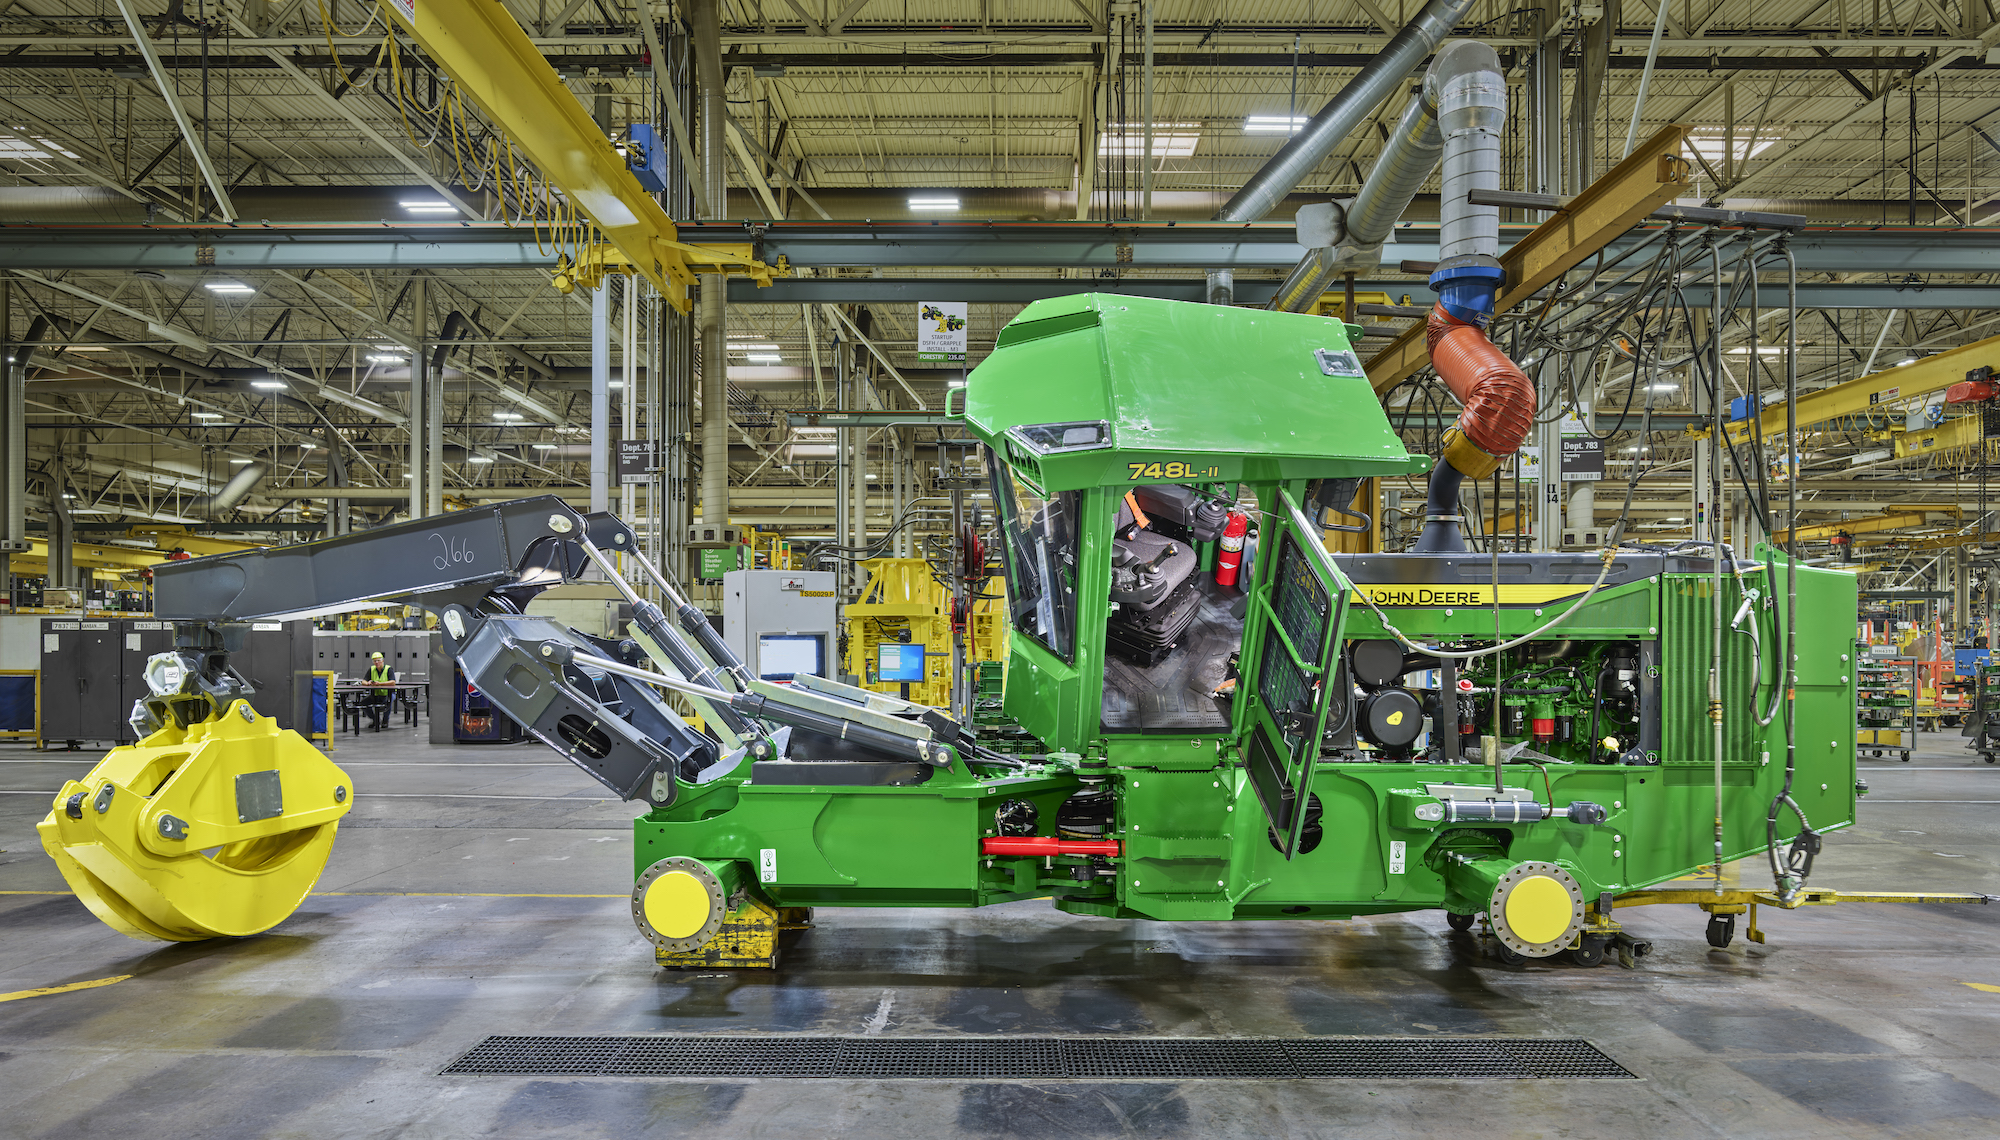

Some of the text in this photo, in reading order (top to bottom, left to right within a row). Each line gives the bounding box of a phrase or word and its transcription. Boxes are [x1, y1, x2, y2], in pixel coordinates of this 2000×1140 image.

[622, 443, 642, 453] Dept.
[1563, 441, 1598, 451] Dept. 783
[428, 533, 474, 570] 266
[1369, 589, 1480, 603] JOHN DEERE
